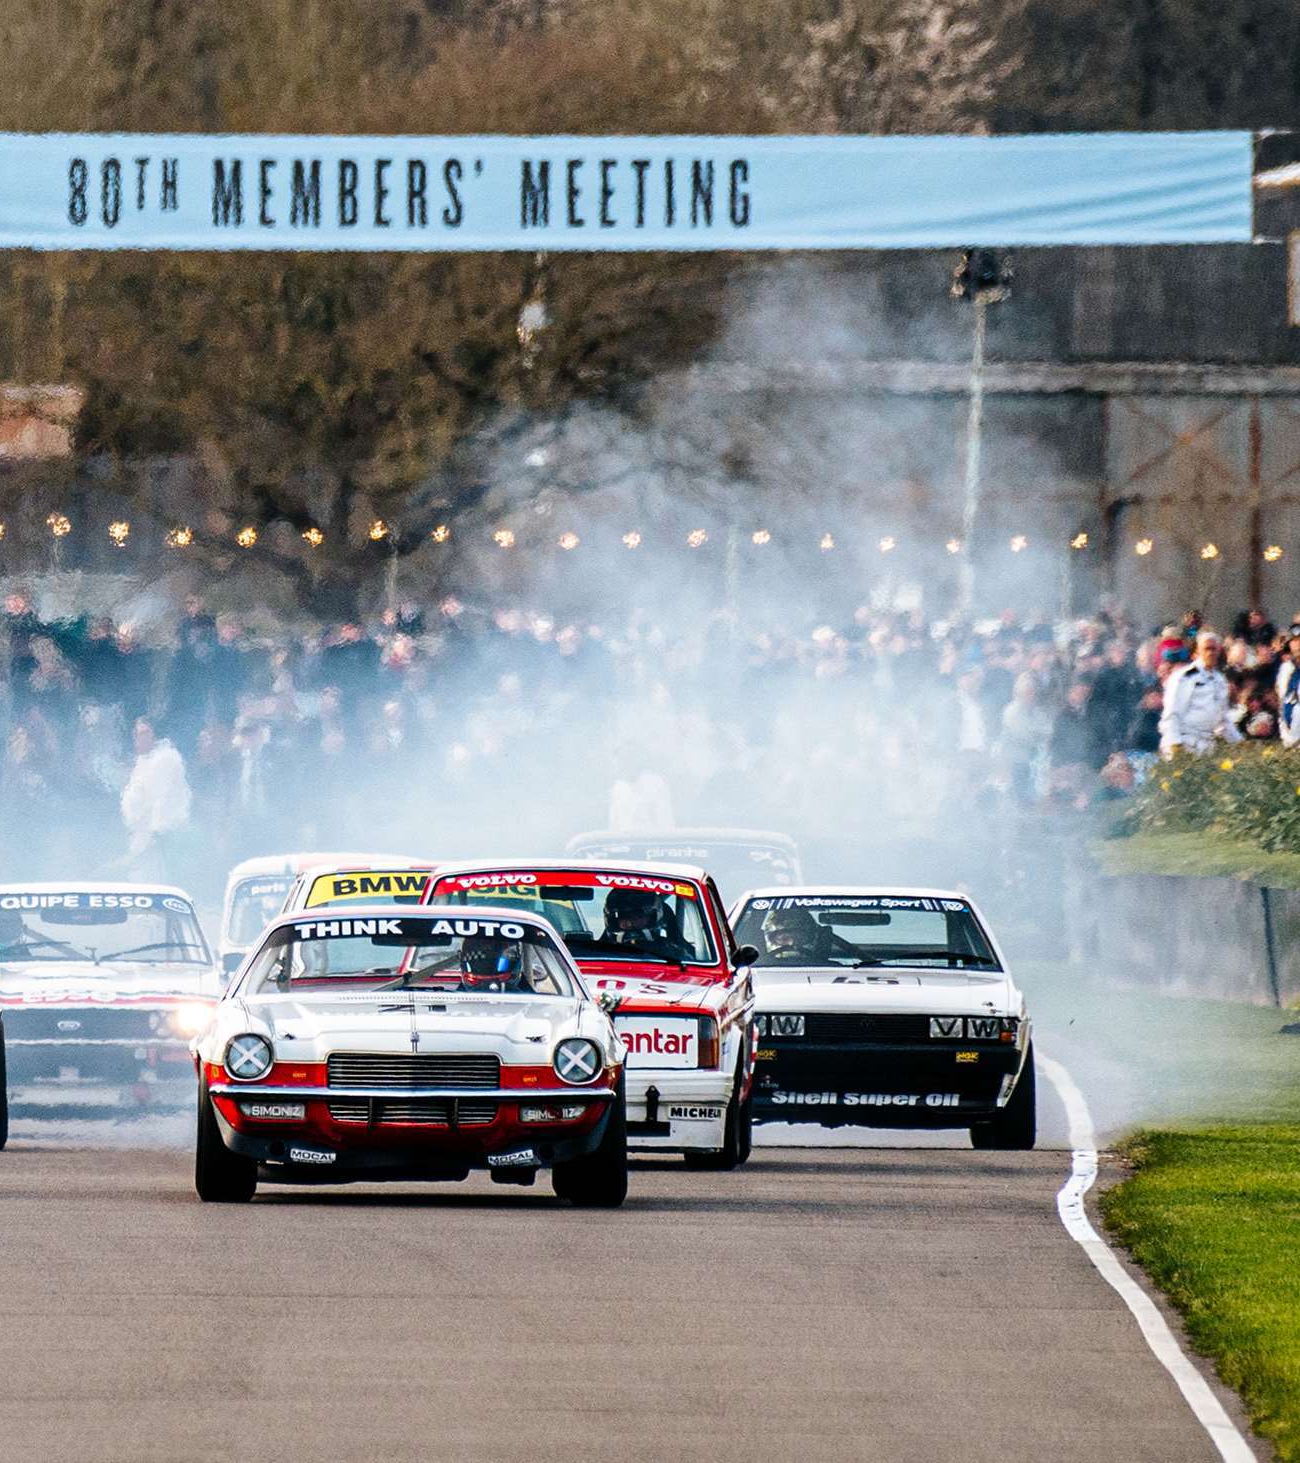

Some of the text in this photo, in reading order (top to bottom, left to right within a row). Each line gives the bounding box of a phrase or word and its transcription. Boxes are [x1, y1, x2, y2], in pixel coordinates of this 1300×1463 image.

[68, 156, 750, 228] 80TH MEMBERS' MEETING
[333, 876, 428, 896] BMW
[458, 874, 537, 888] VOLVO
[595, 875, 675, 892] VOLVO
[89, 895, 153, 908] ESSO
[795, 898, 922, 909] Volkswagen Sport
[295, 919, 525, 939] THINK AUTO
[620, 1028, 693, 1054] antar
[772, 1091, 837, 1104] Shell
[844, 1092, 920, 1106] Super
[251, 1105, 301, 1117] SIMONIZ
[528, 1108, 578, 1119] SIMIZ
[292, 1150, 335, 1161] MOCAL
